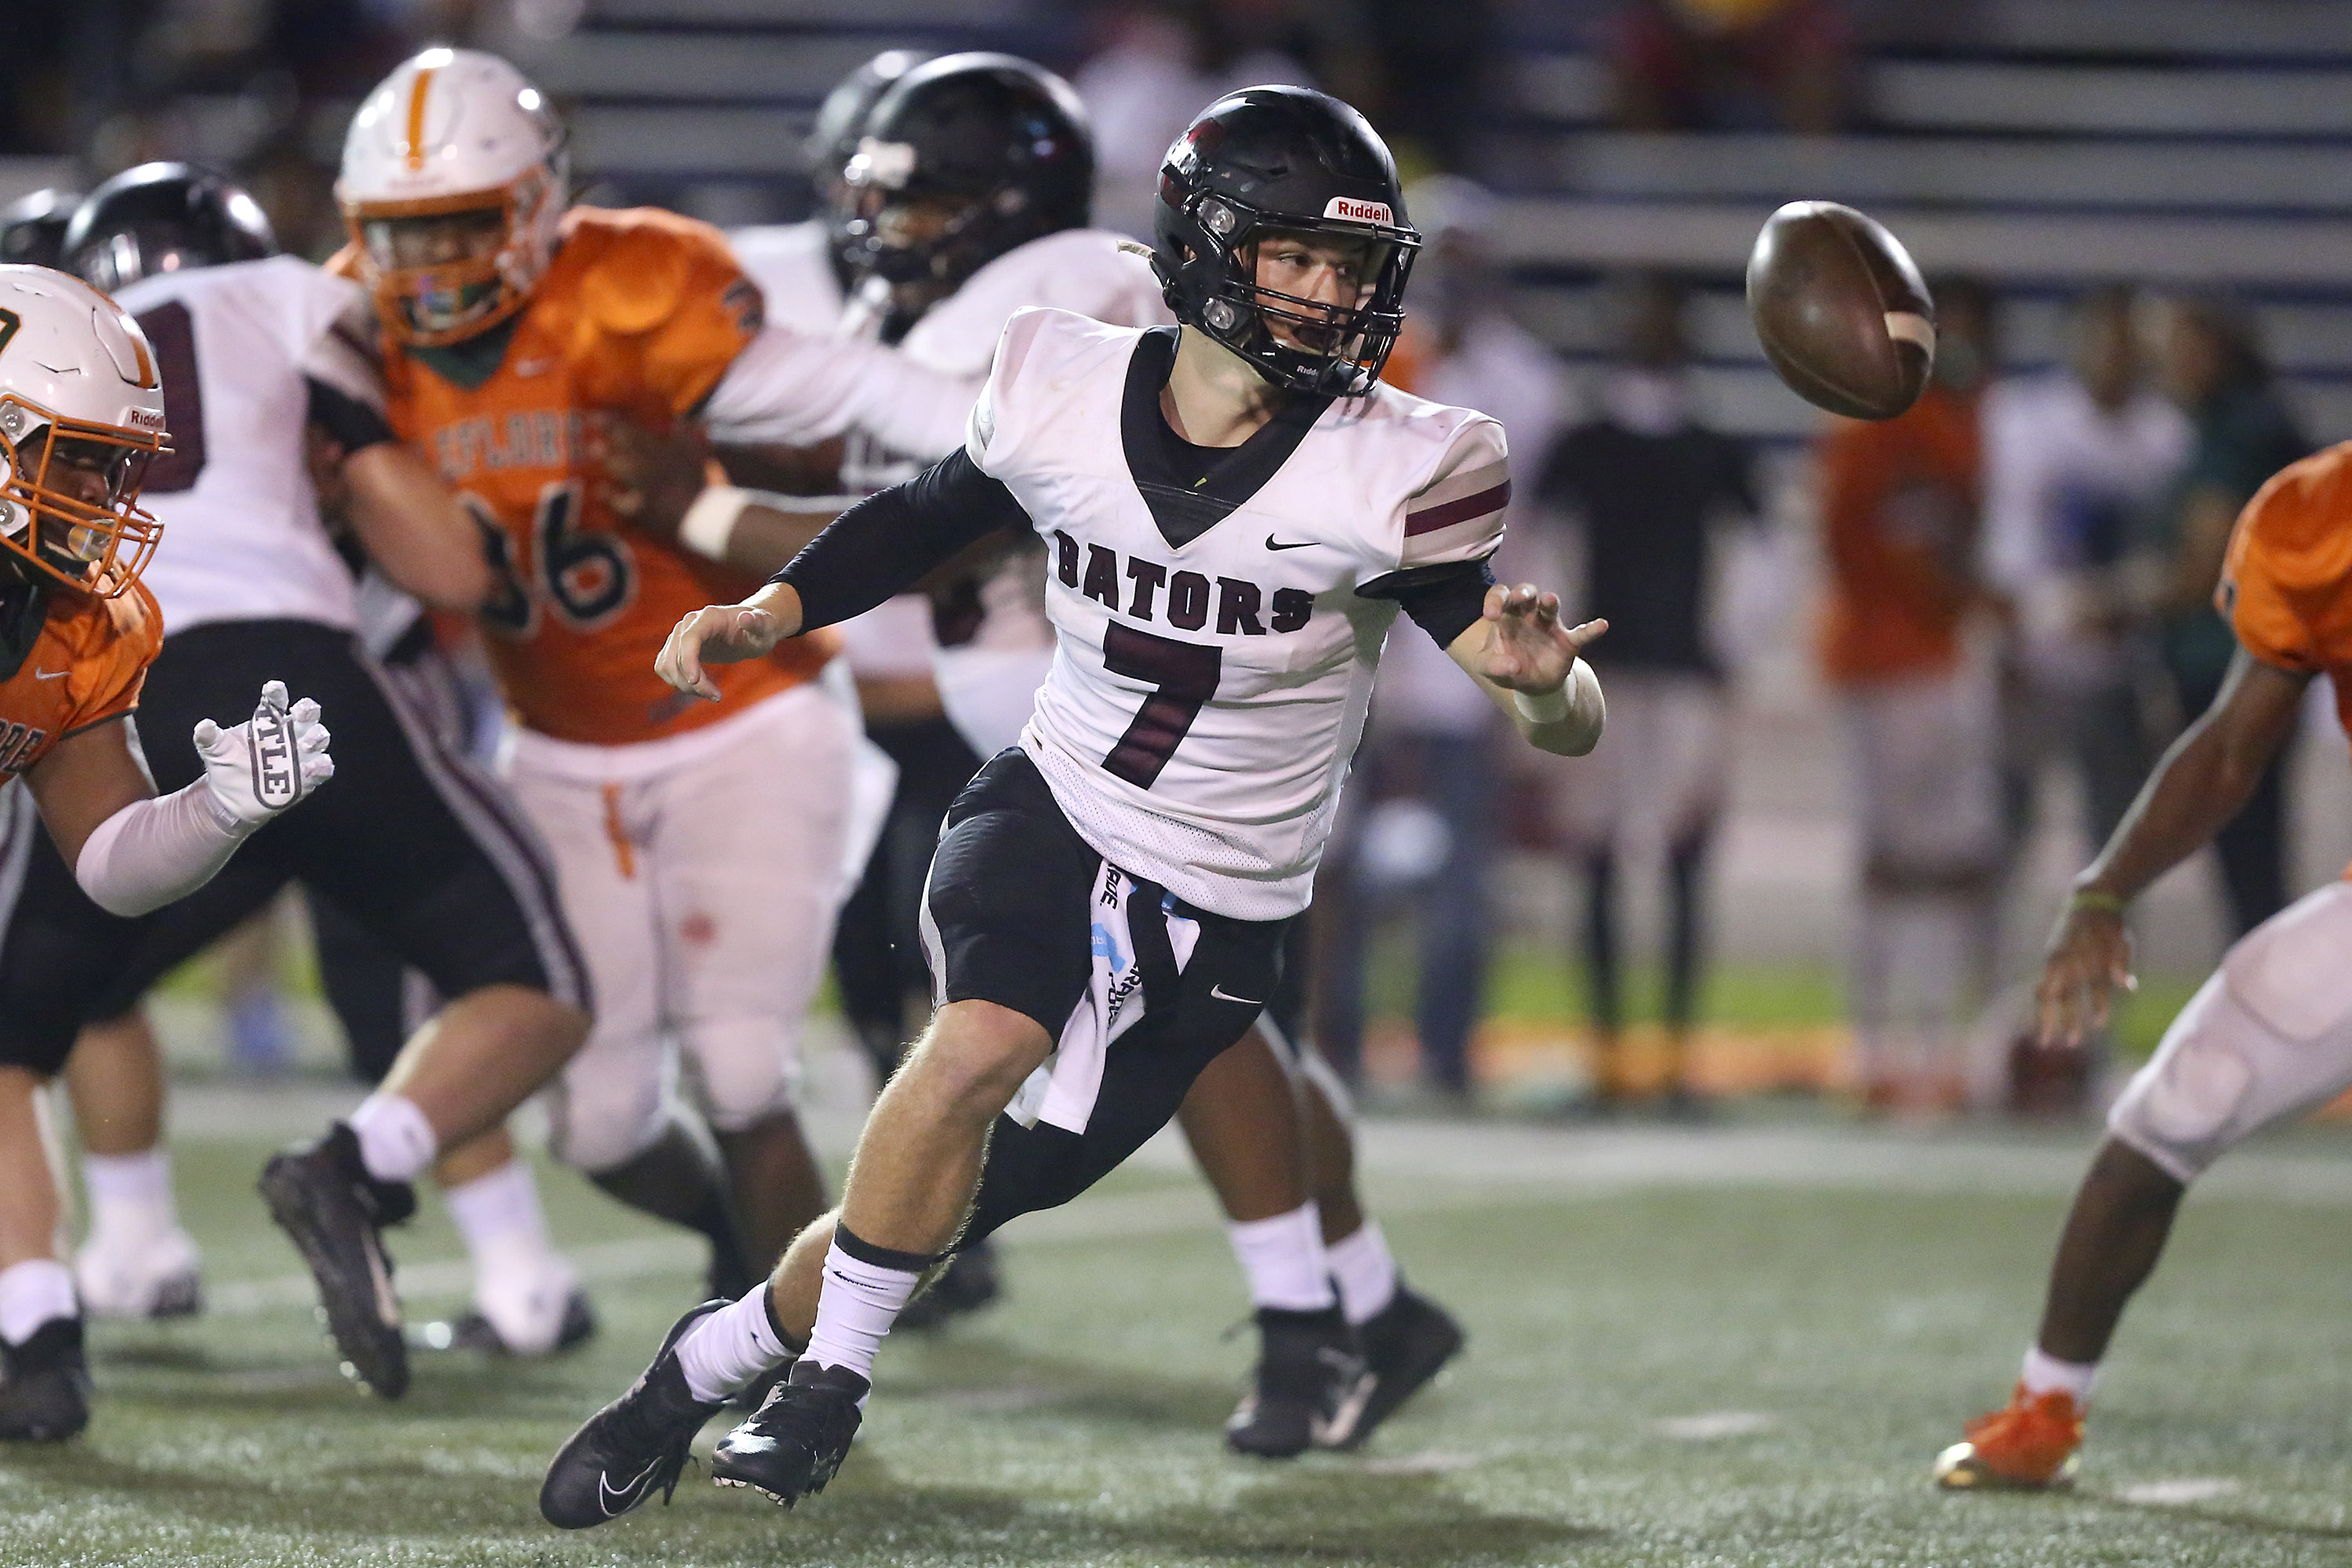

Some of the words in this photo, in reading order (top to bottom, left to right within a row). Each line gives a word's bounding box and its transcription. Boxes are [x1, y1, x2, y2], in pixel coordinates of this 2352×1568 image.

[1338, 201, 1388, 222] Riddell
[1296, 365, 1319, 376] Ridd
[1053, 528, 1316, 636] GATORS
[1101, 619, 1223, 790] 7
